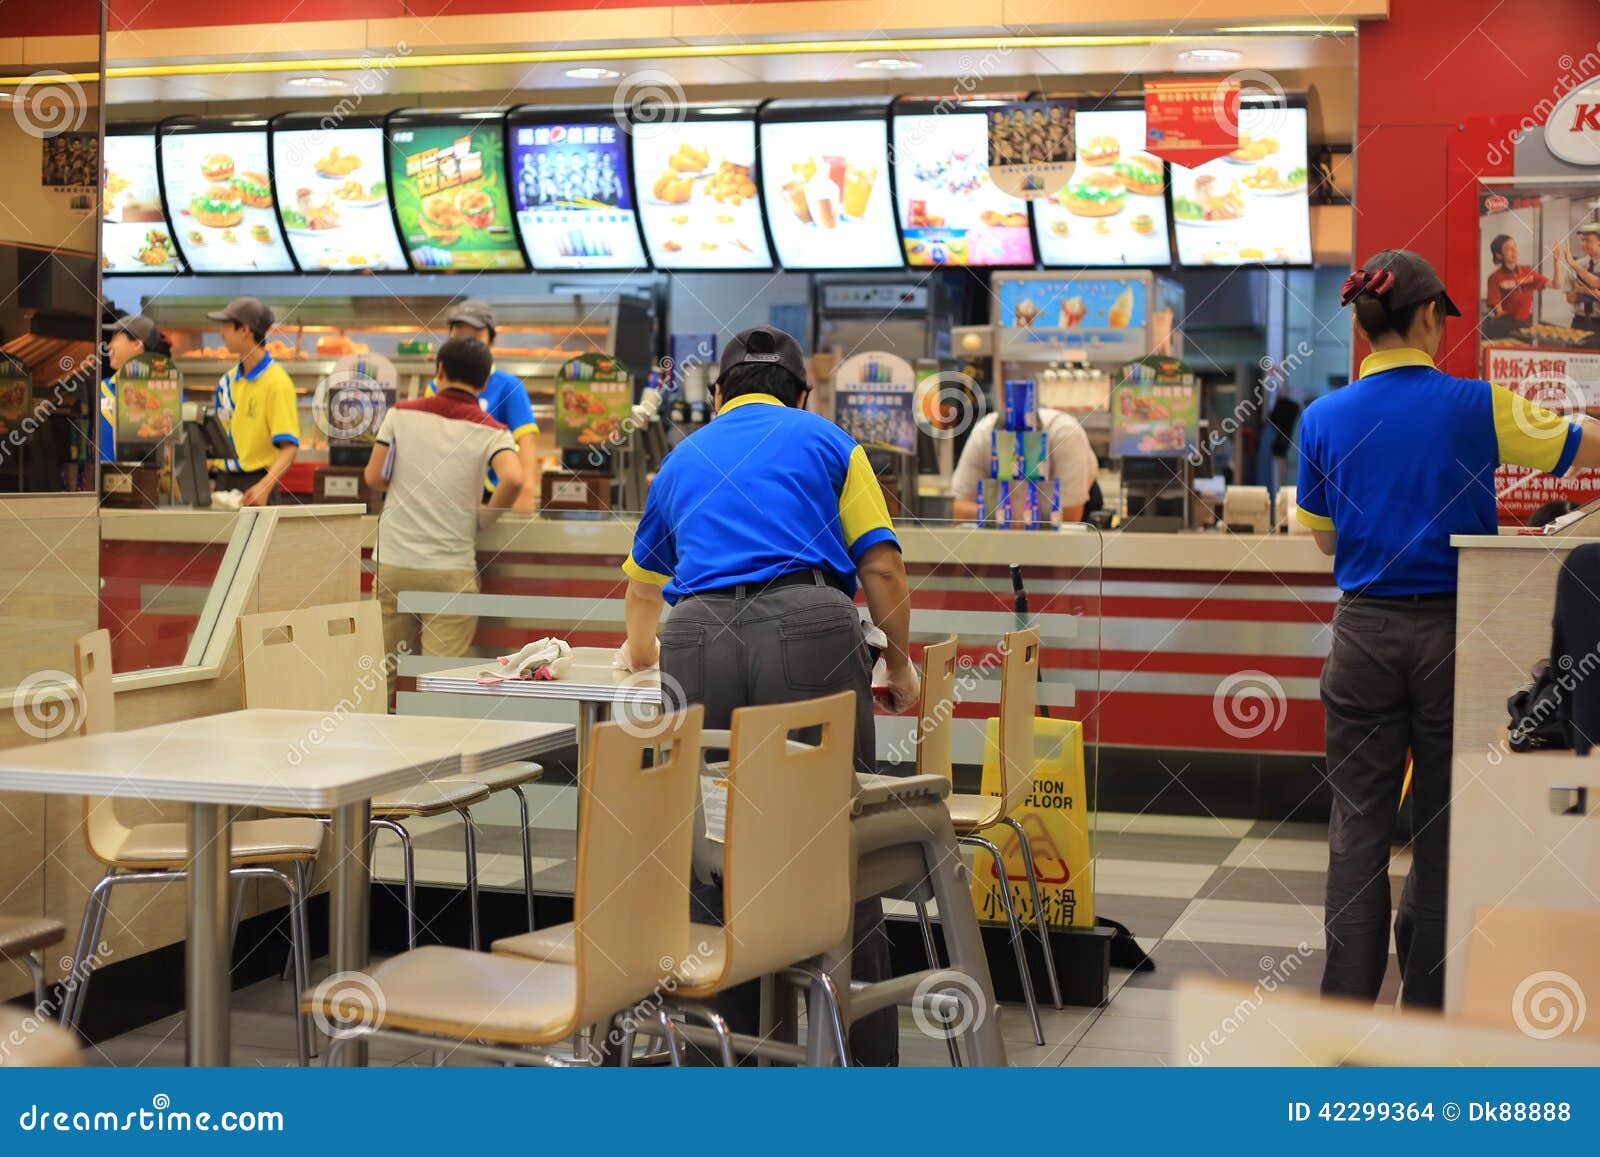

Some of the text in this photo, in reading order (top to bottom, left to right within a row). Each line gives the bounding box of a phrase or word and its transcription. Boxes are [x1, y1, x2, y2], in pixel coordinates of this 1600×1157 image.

[1033, 780, 1064, 793] TION
[1024, 795, 1073, 809] FLOOR
[983, 884, 1077, 926] 小心地滑
